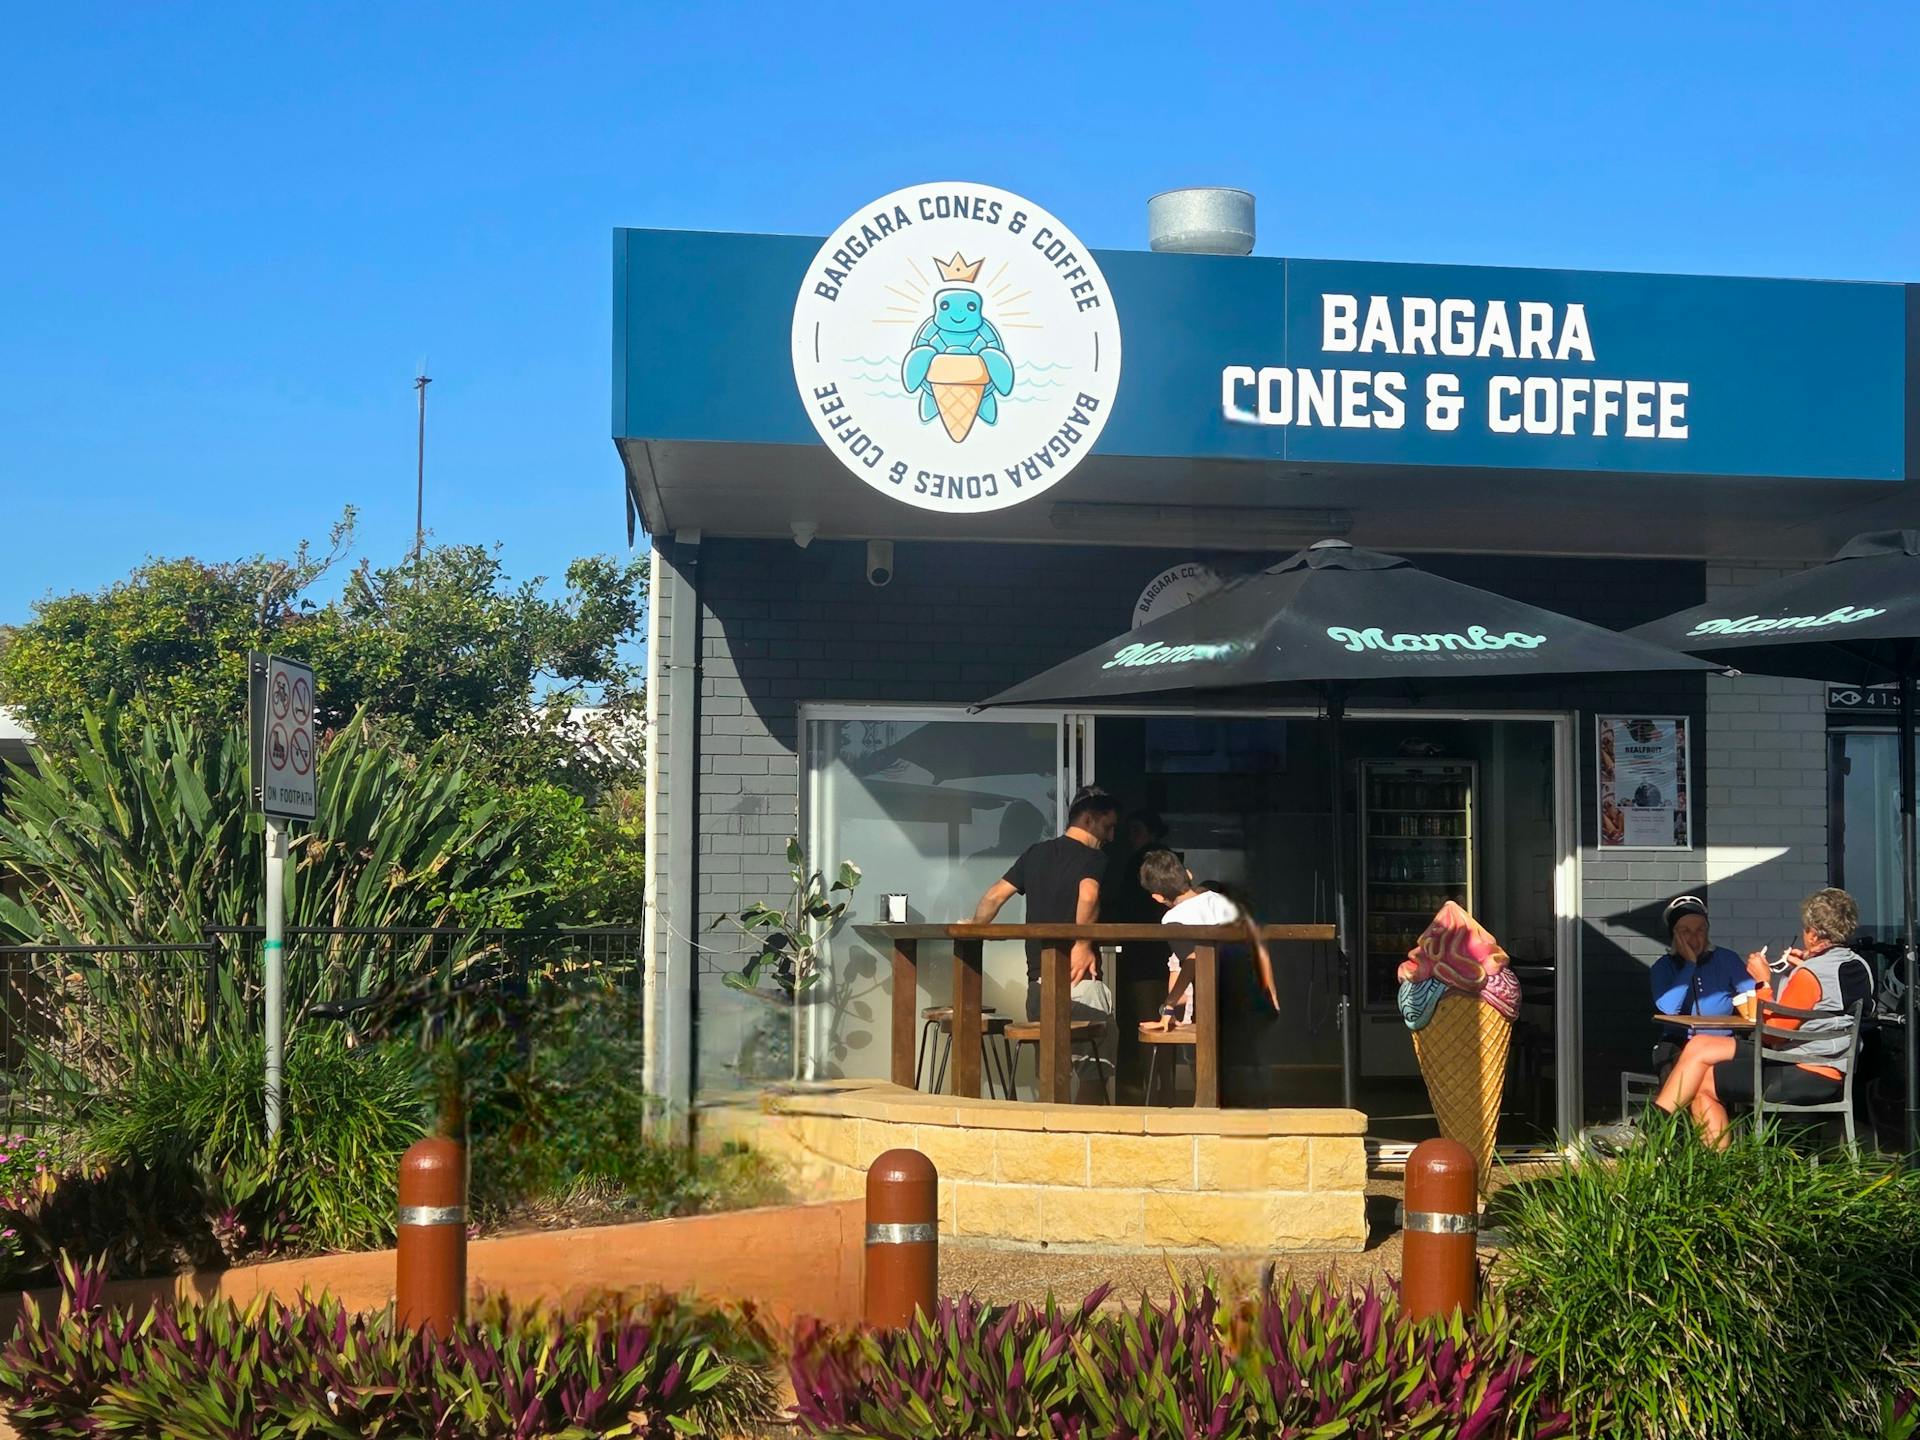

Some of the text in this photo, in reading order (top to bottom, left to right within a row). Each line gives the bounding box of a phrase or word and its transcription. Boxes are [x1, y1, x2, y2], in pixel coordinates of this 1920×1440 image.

[814, 195, 1101, 313] BARGARA CONES & COFFEE
[1321, 293, 1596, 361] BARGARA
[1222, 365, 1689, 439] CONES & COFFEE
[813, 382, 1100, 499] BARGARA CONES & COFFEE
[1139, 571, 1179, 613] BARGARA
[1326, 625, 1547, 652] Mambo
[1686, 605, 1888, 637] Mambo
[267, 785, 313, 807] ON FOOTPATH
